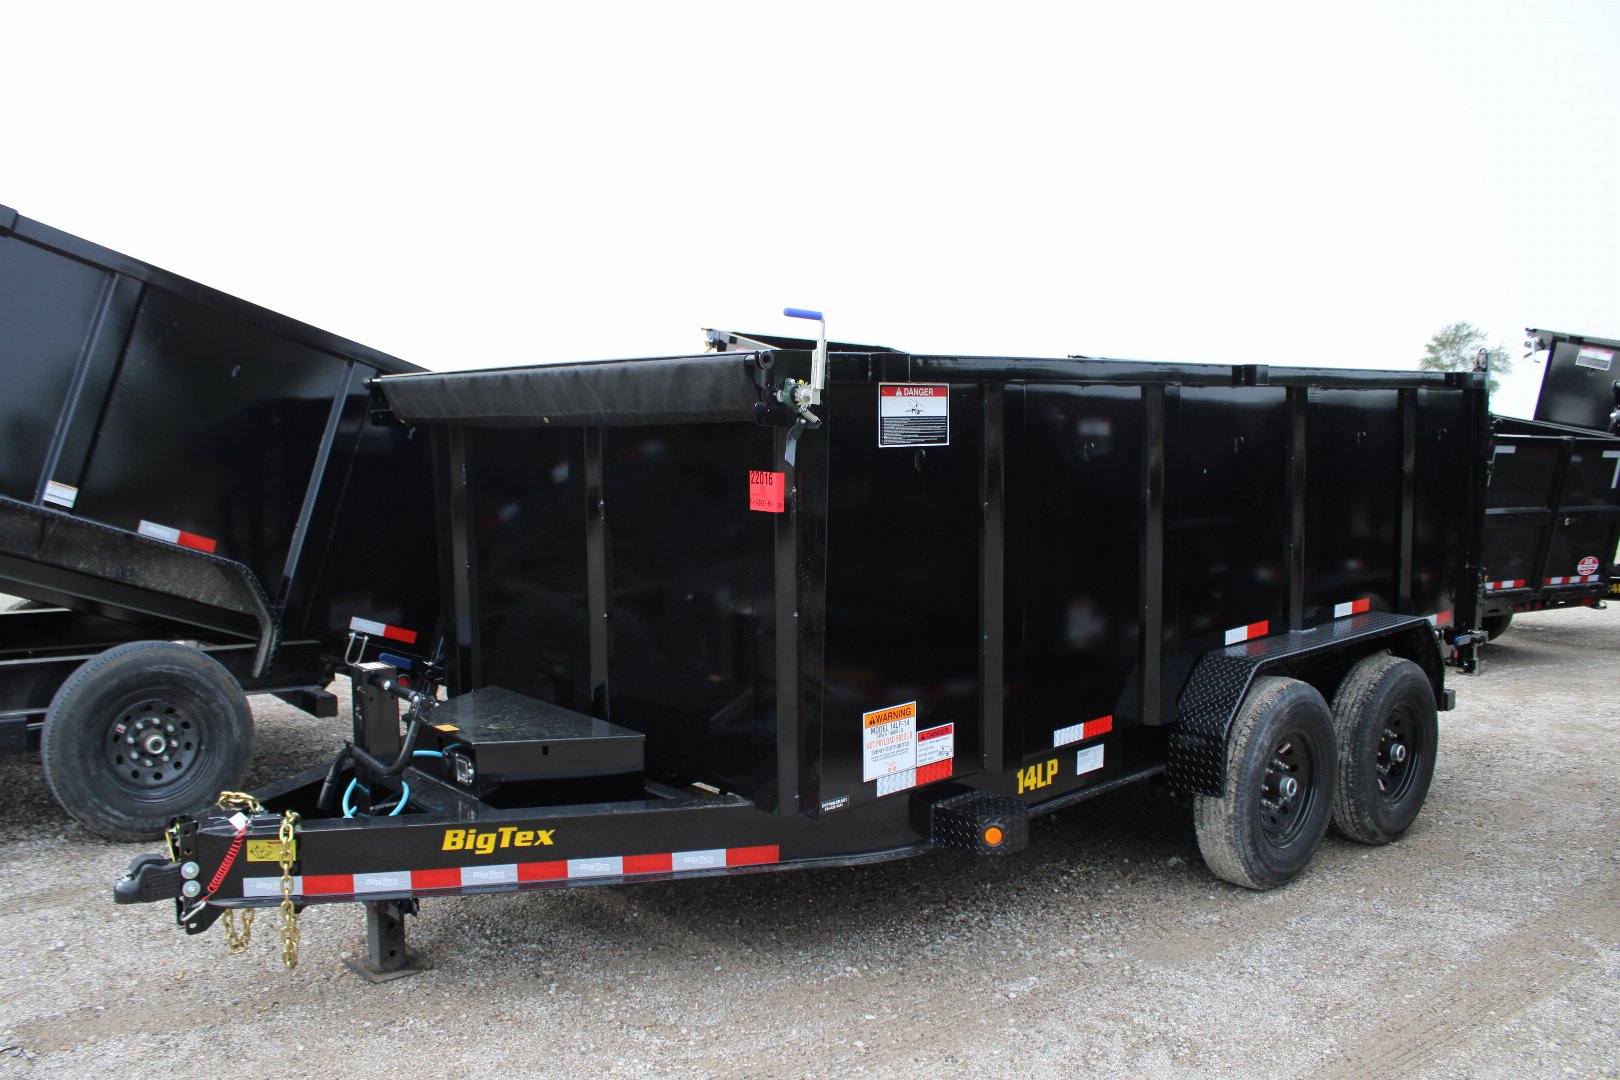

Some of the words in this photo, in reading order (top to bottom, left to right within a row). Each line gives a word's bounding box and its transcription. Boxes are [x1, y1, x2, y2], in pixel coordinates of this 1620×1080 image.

[903, 387, 934, 396] DANGER
[750, 471, 773, 486] 22016
[875, 707, 912, 723] WARNING
[870, 725, 888, 736] MODEL
[1016, 758, 1059, 795] 14LP
[441, 826, 556, 855] BigTex
